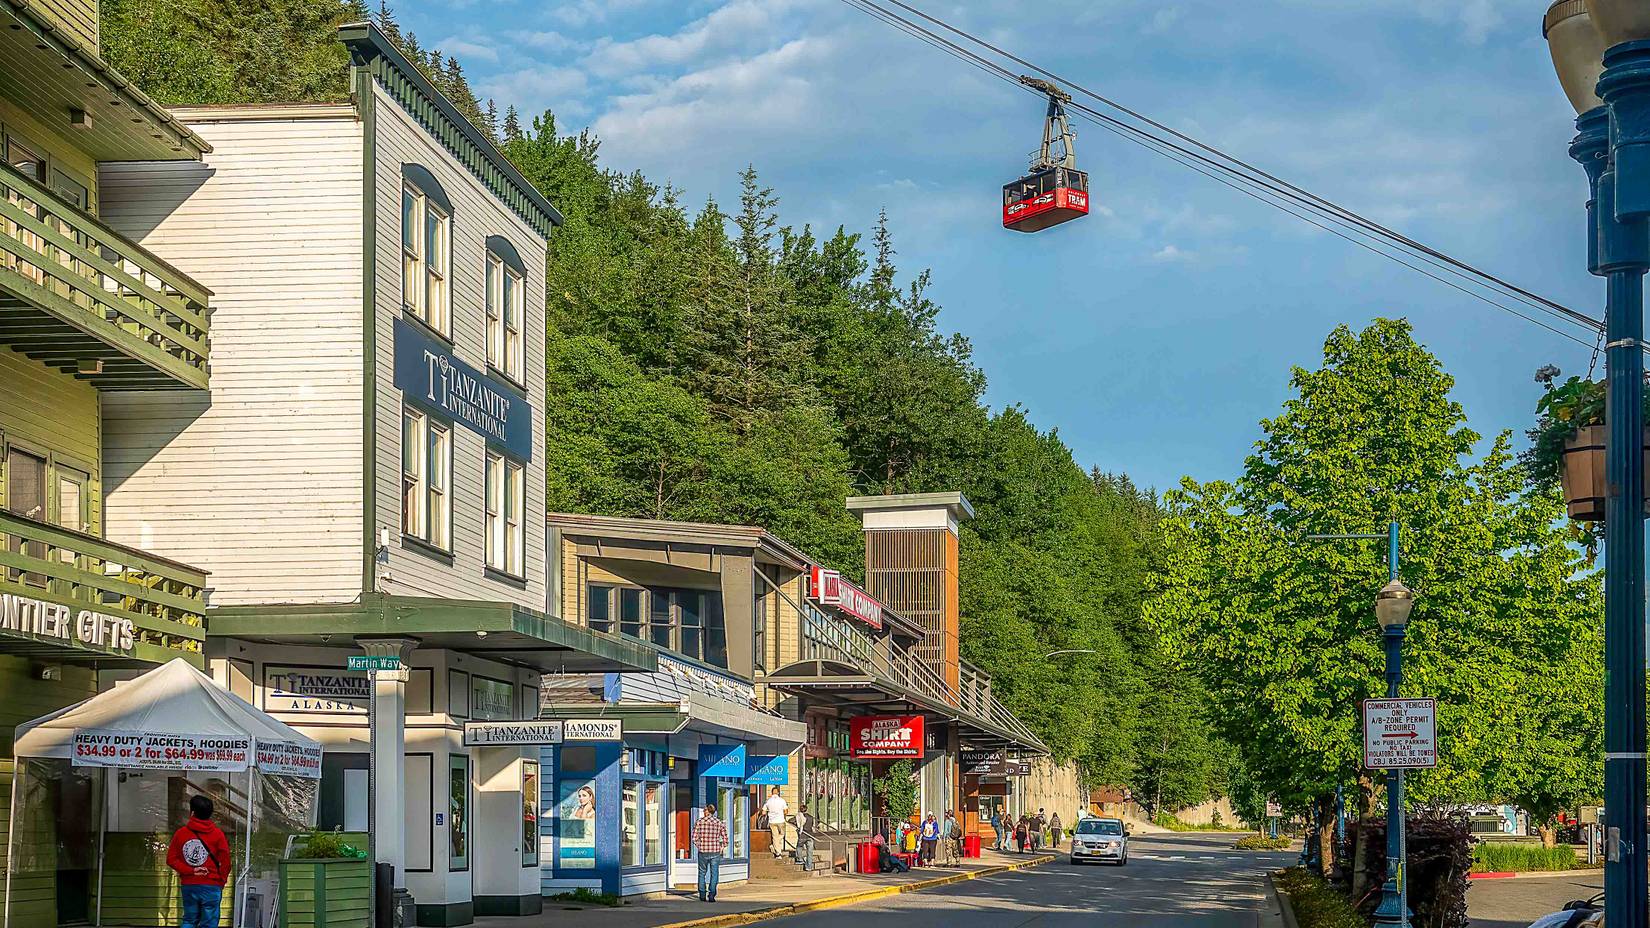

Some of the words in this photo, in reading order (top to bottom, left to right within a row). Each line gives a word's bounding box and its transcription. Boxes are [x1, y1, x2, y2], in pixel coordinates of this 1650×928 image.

[1068, 194, 1086, 207] TRAM
[448, 366, 507, 422] TANZANITE
[450, 394, 506, 442] INTERNATIONAL
[856, 593, 881, 626] COMPANY
[0, 594, 70, 639] NTIER
[76, 610, 134, 650] GIFTS
[349, 658, 378, 668] Martin
[380, 658, 400, 669] Way
[292, 700, 354, 710] ALASKA
[493, 726, 555, 736] TANZANITE
[563, 724, 614, 732] IAMONDS
[861, 728, 912, 740] SHIRT
[75, 735, 111, 744] HEAVY
[114, 736, 143, 745] DUTY
[146, 738, 196, 748] JACKETS,
[200, 740, 248, 749] HOODIES
[77, 744, 116, 757] $34.99
[120, 748, 132, 757] or
[135, 747, 142, 757] 2
[145, 748, 161, 758] for
[165, 748, 204, 760] $64.99
[704, 754, 740, 763] MILANO
